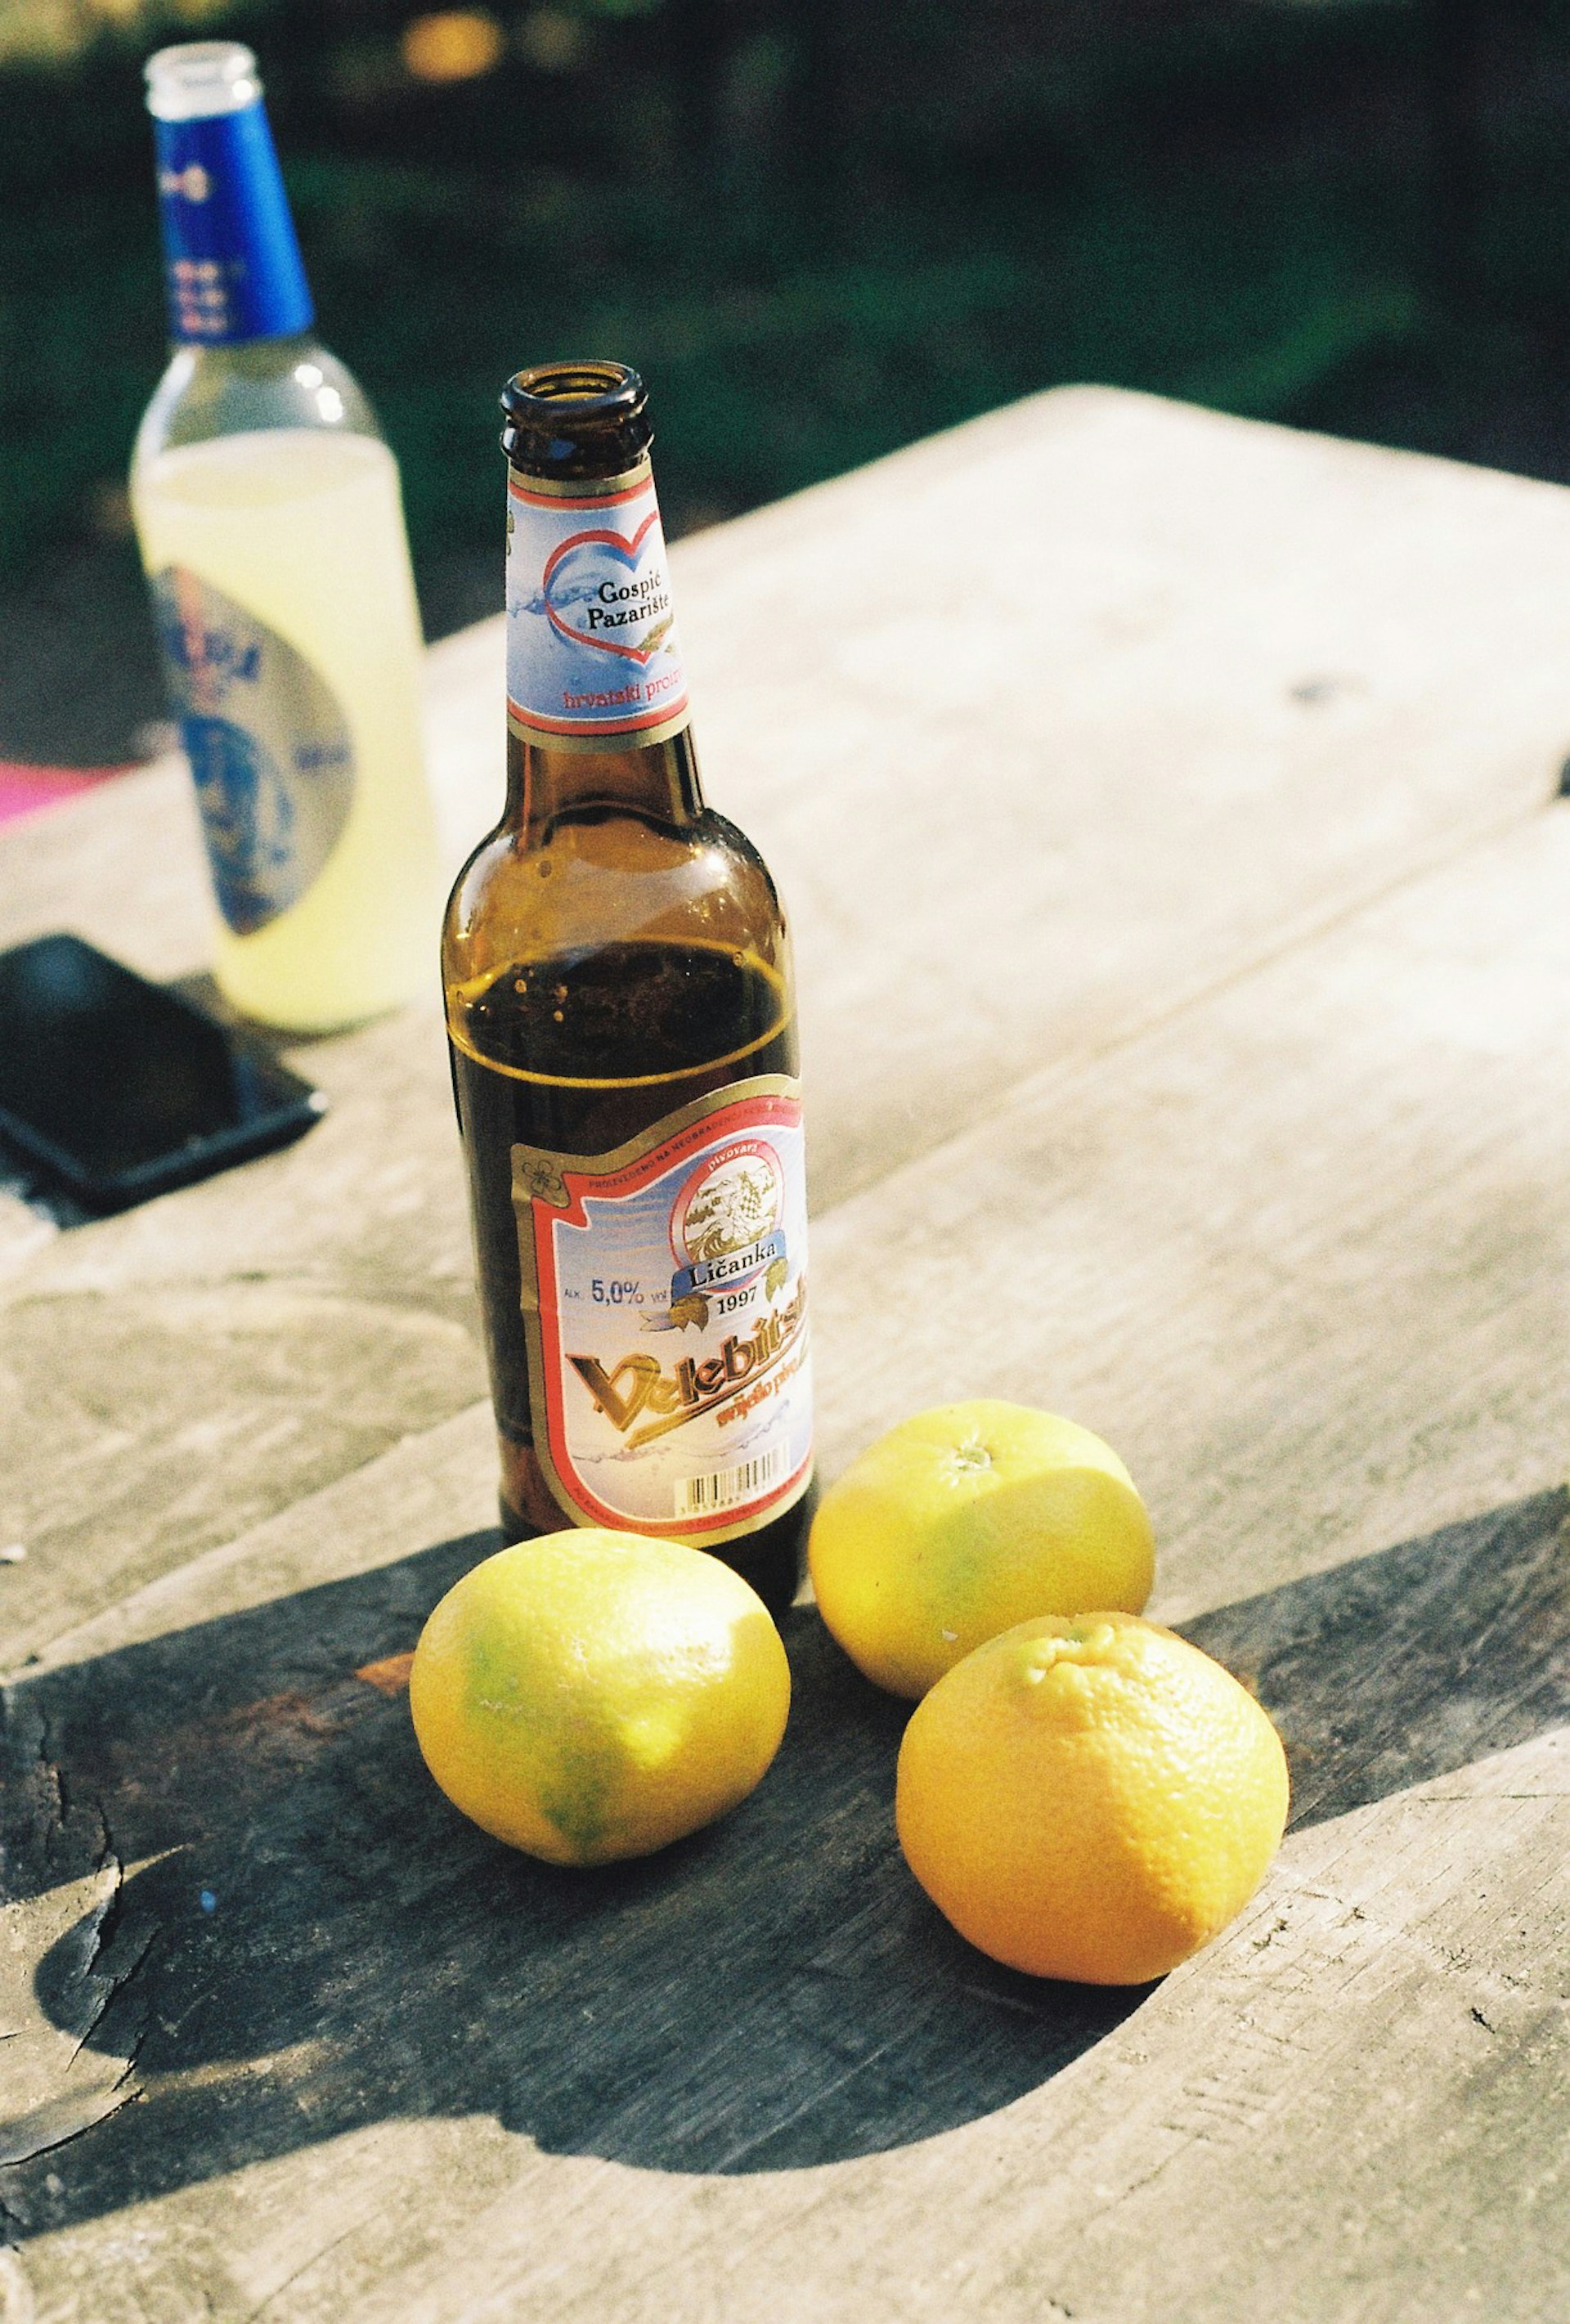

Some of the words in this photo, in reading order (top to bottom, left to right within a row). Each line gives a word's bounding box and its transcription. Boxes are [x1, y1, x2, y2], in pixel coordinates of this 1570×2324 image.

[598, 568, 662, 603] Gospić
[588, 594, 669, 630] Pazarište
[563, 682, 641, 709] hrvatski
[656, 1150, 670, 1162] NA
[707, 1143, 758, 1171] pivovara
[689, 1242, 776, 1288] Ličanka
[591, 1279, 644, 1307] 5,0%
[717, 1286, 757, 1315] 1997
